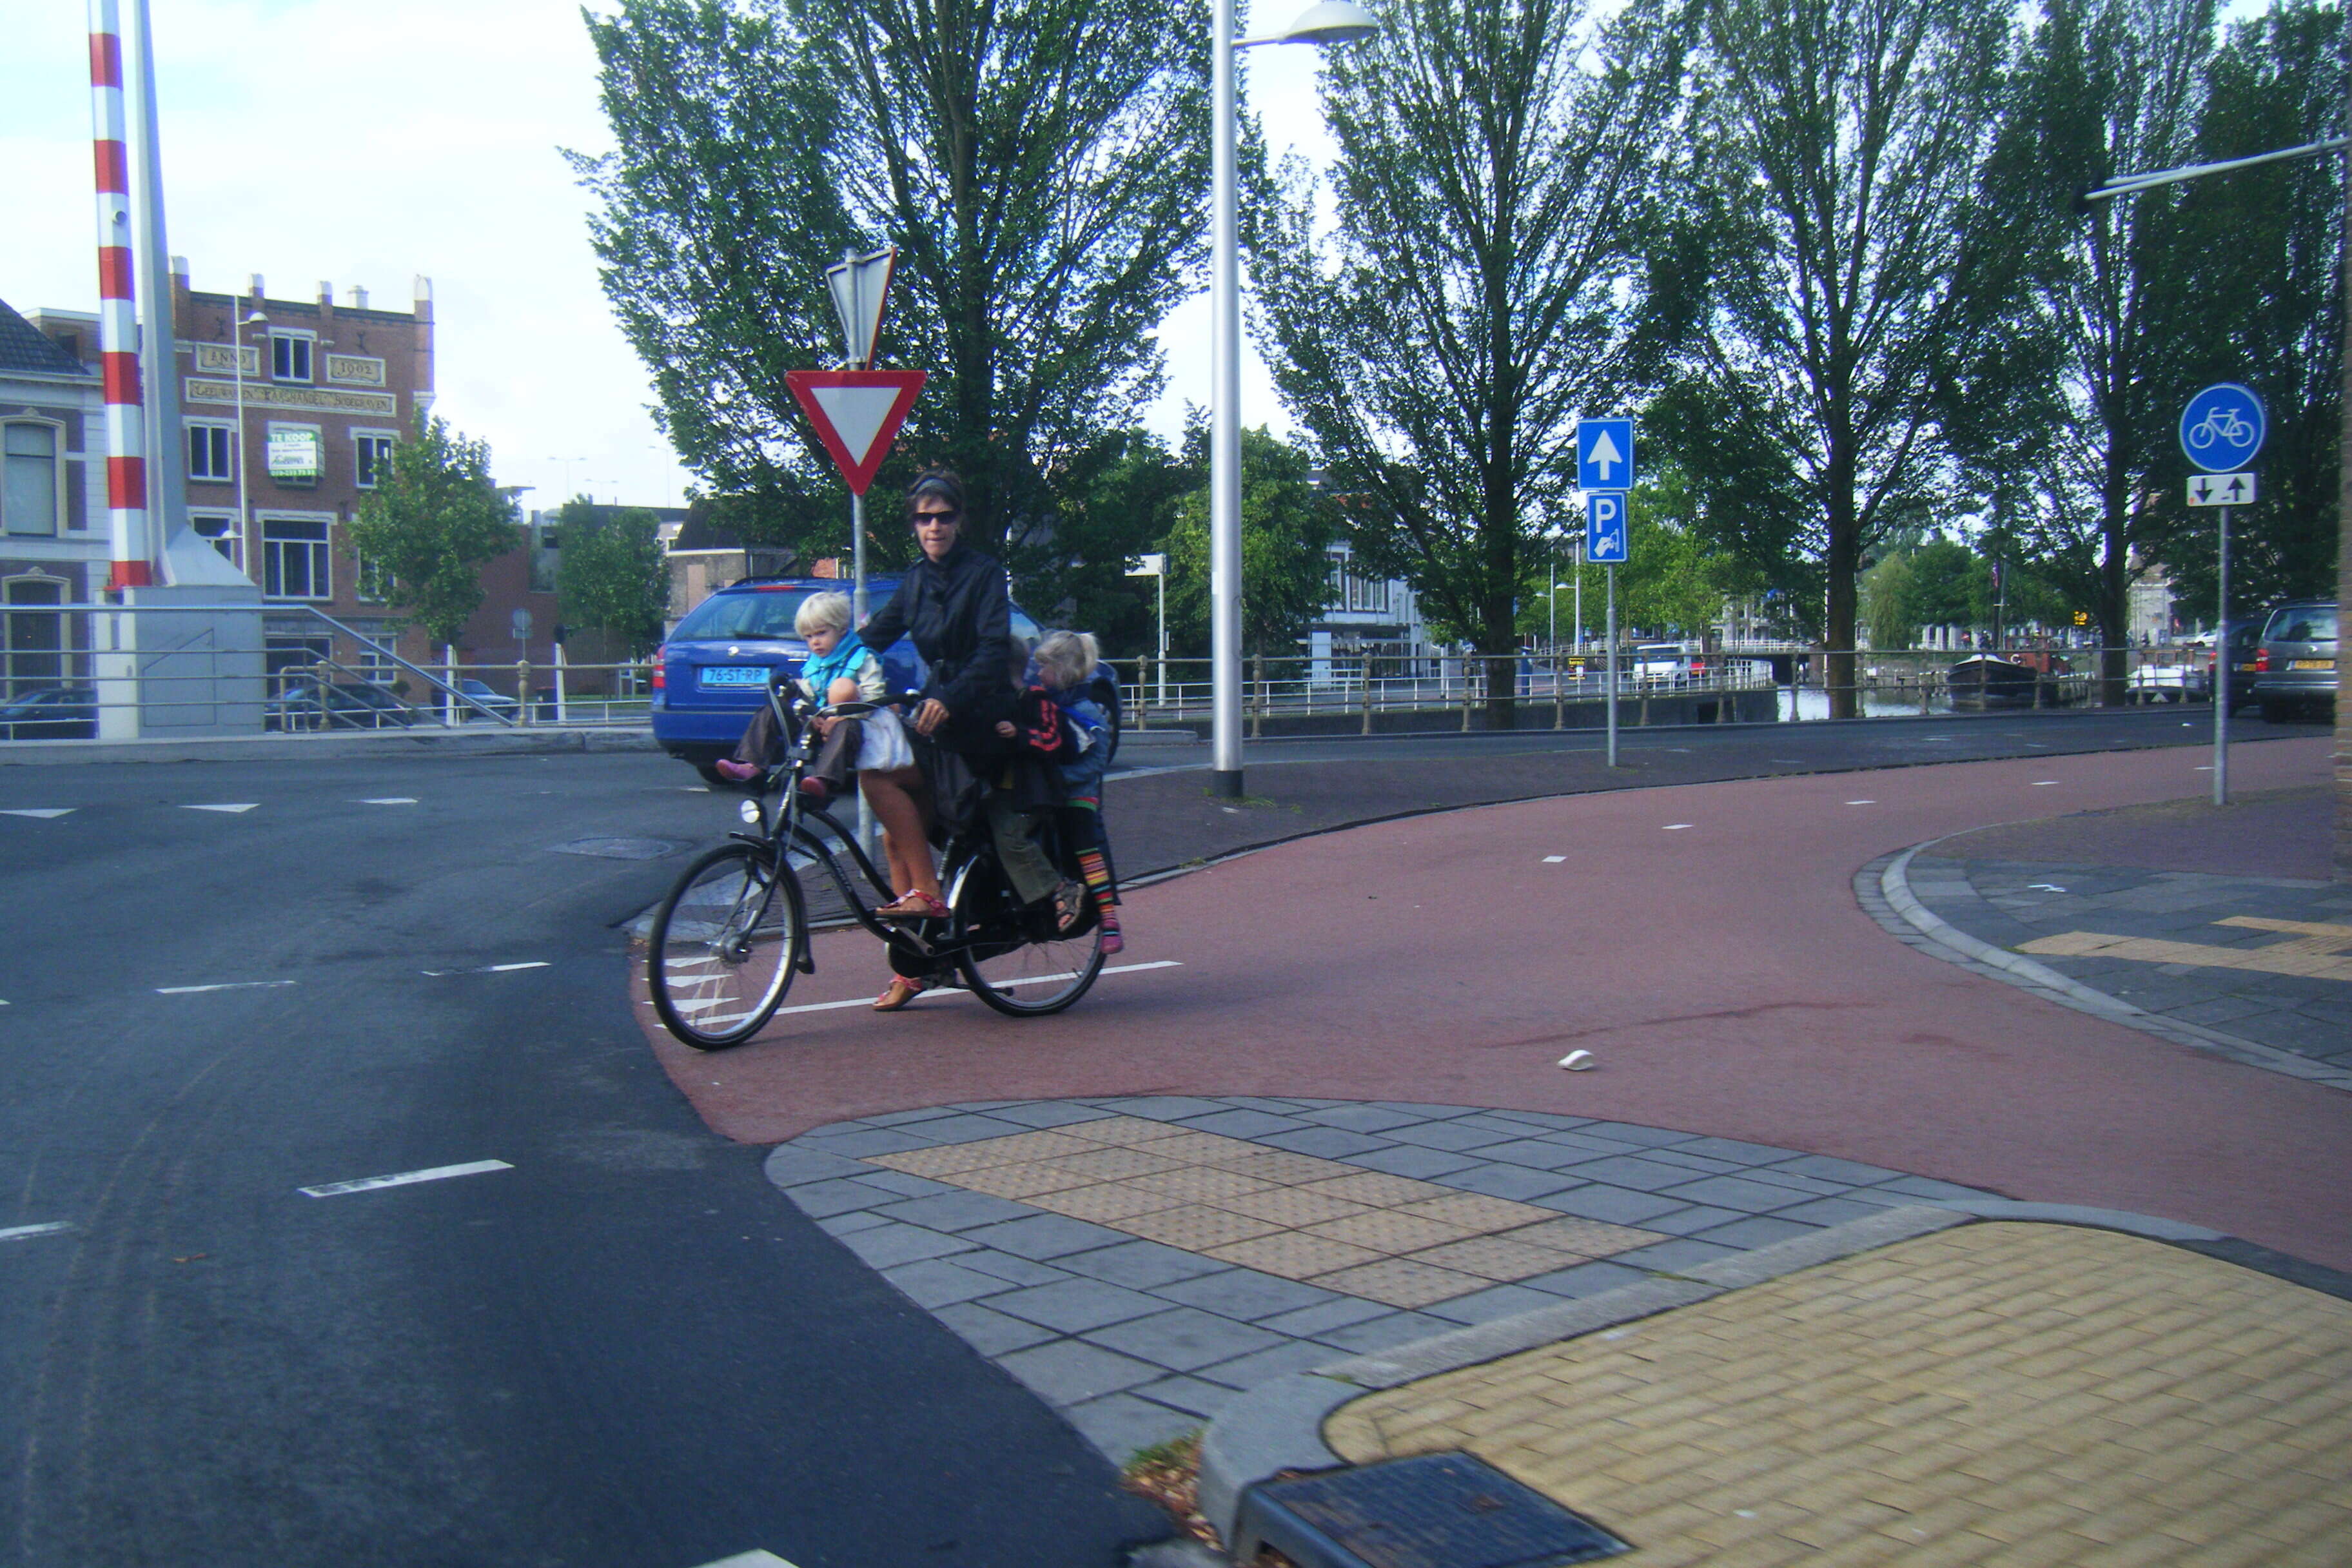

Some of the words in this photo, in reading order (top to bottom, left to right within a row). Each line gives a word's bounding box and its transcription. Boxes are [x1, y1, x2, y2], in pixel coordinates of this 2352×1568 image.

[210, 351, 246, 364] ANNO
[338, 362, 373, 375] 1902
[270, 434, 282, 442] TE
[284, 433, 313, 442] KOOP
[1595, 498, 1616, 533] P
[709, 669, 762, 681] 76-ST-RP
